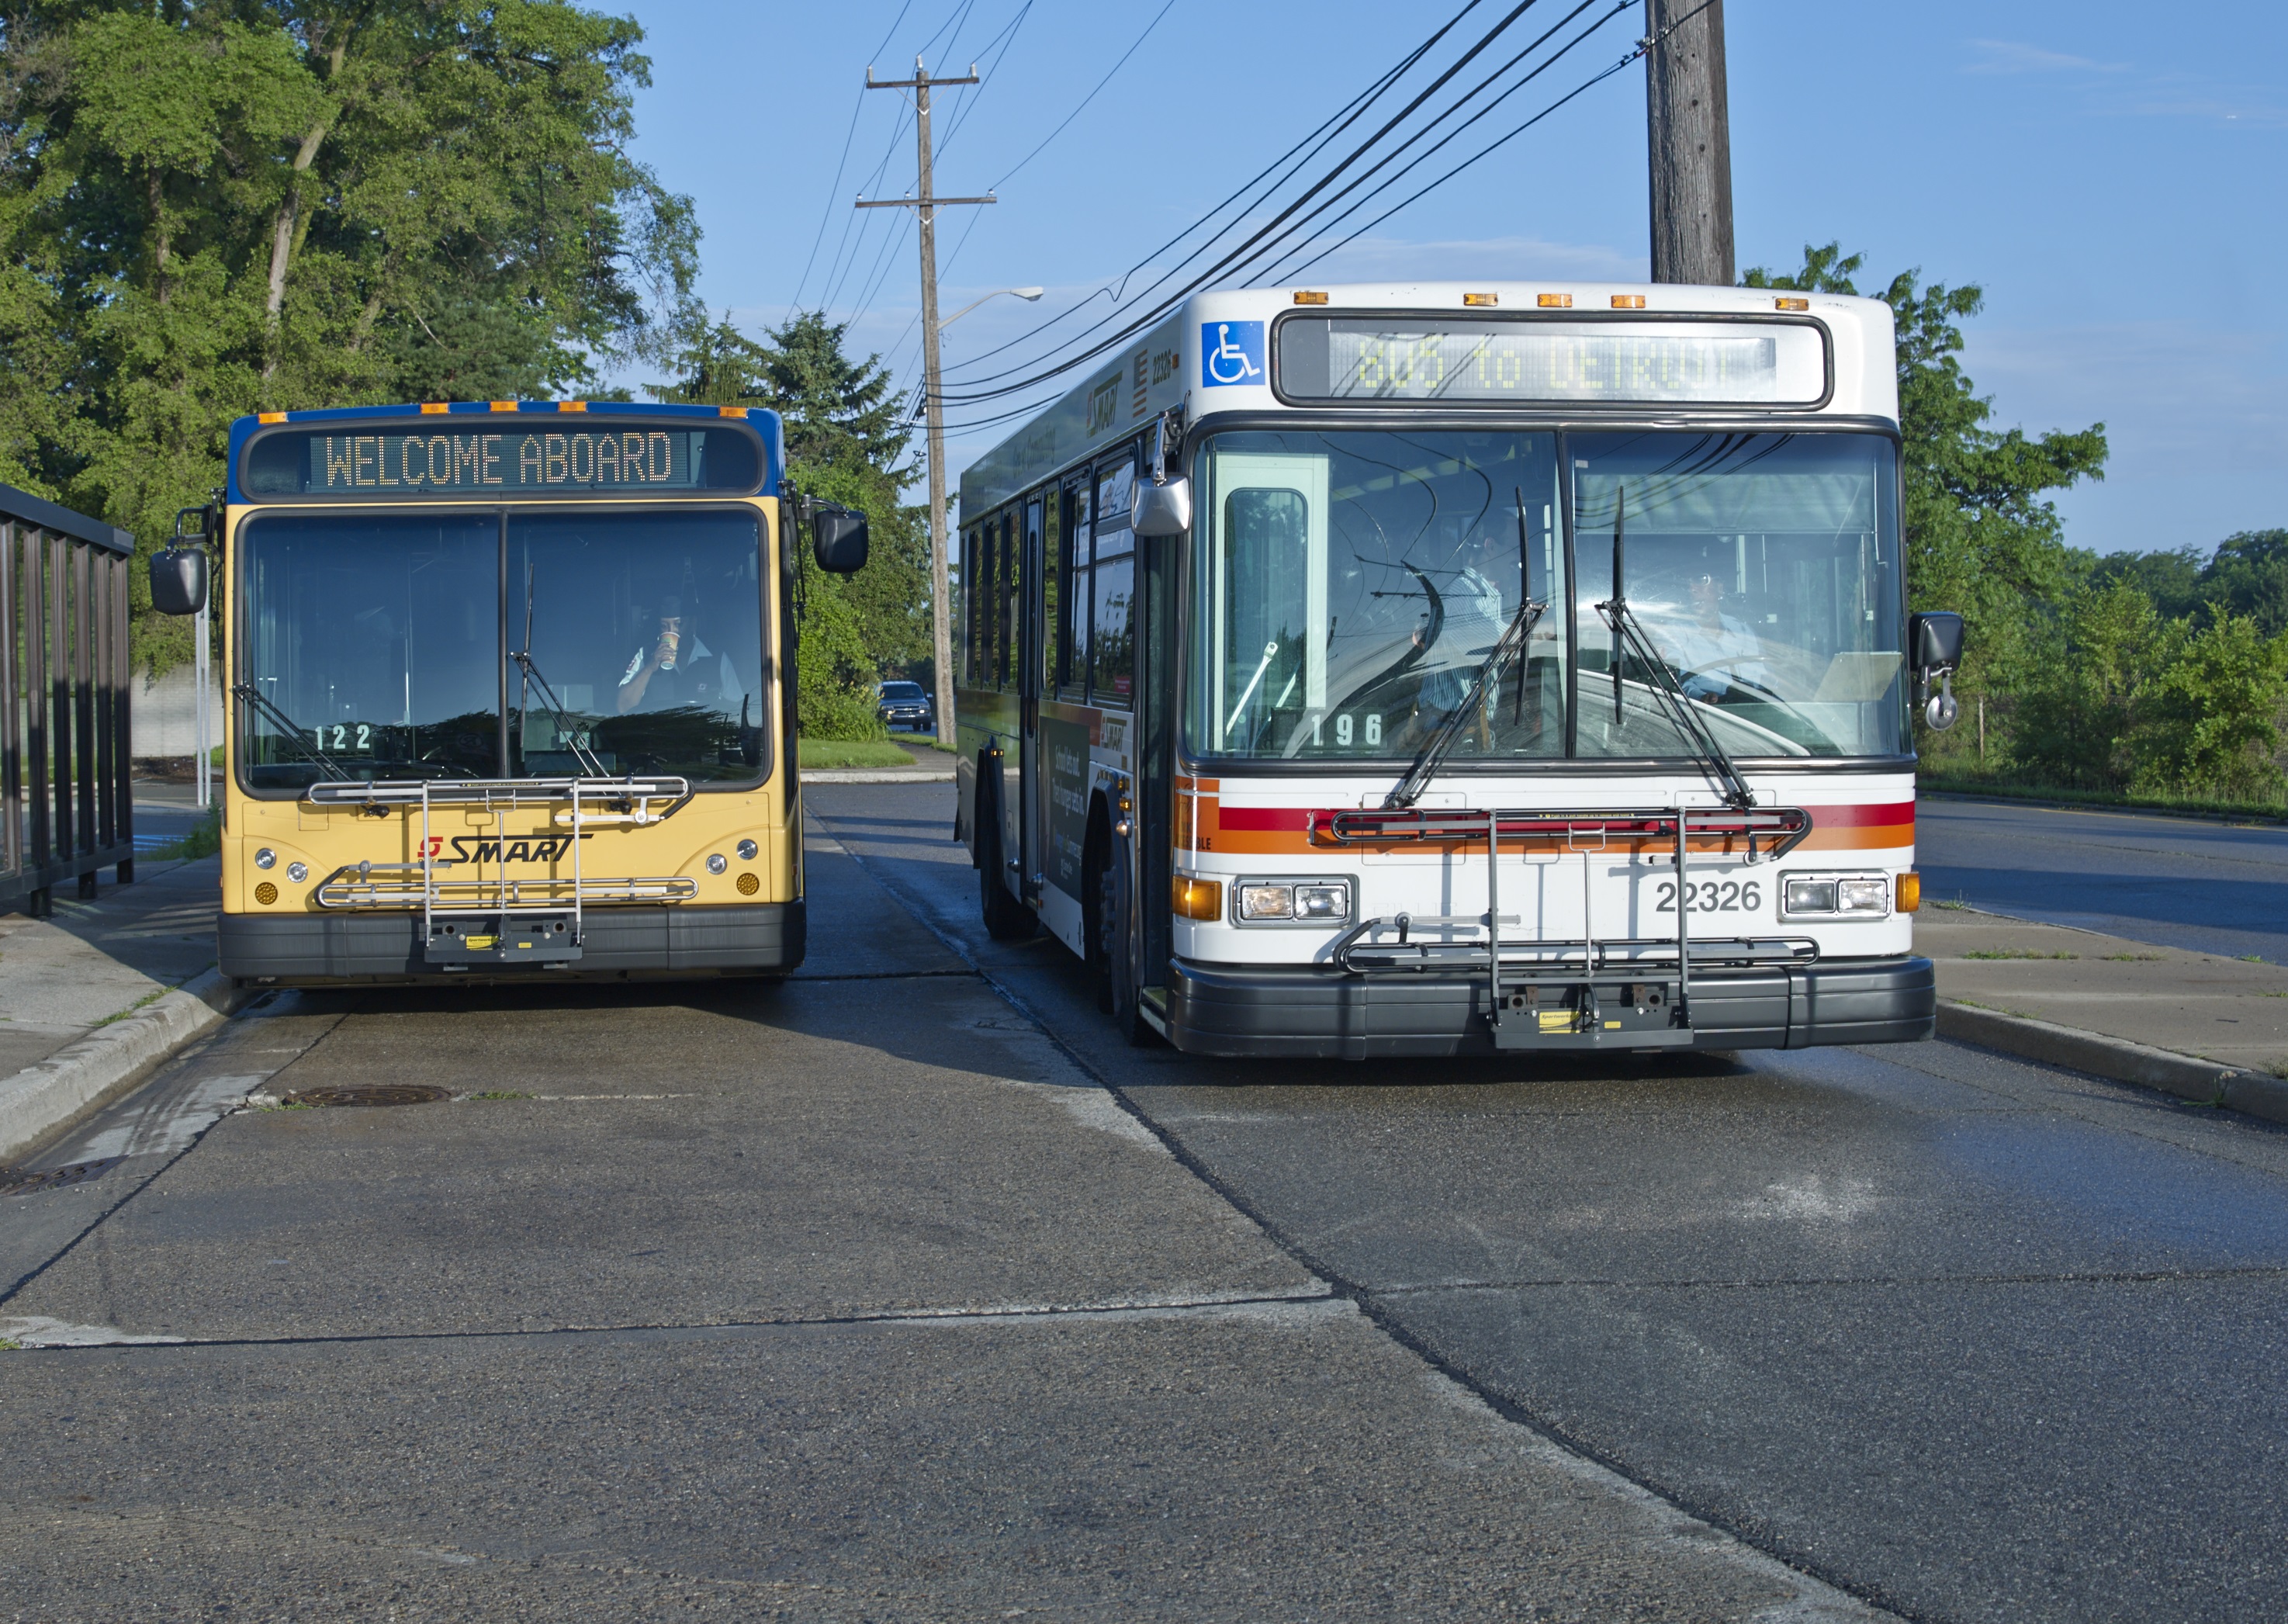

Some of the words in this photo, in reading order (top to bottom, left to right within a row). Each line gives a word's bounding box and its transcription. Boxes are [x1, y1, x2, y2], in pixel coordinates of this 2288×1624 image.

[1152, 348, 1172, 386] 22326
[1089, 369, 1123, 438] SMART
[326, 434, 504, 487] WELCOME
[520, 431, 671, 483] ABOARD
[314, 724, 370, 751] 122
[1104, 716, 1127, 753] SMART
[1311, 714, 1382, 746] 196
[437, 833, 594, 864] SMART
[1656, 881, 1761, 912] 22326
